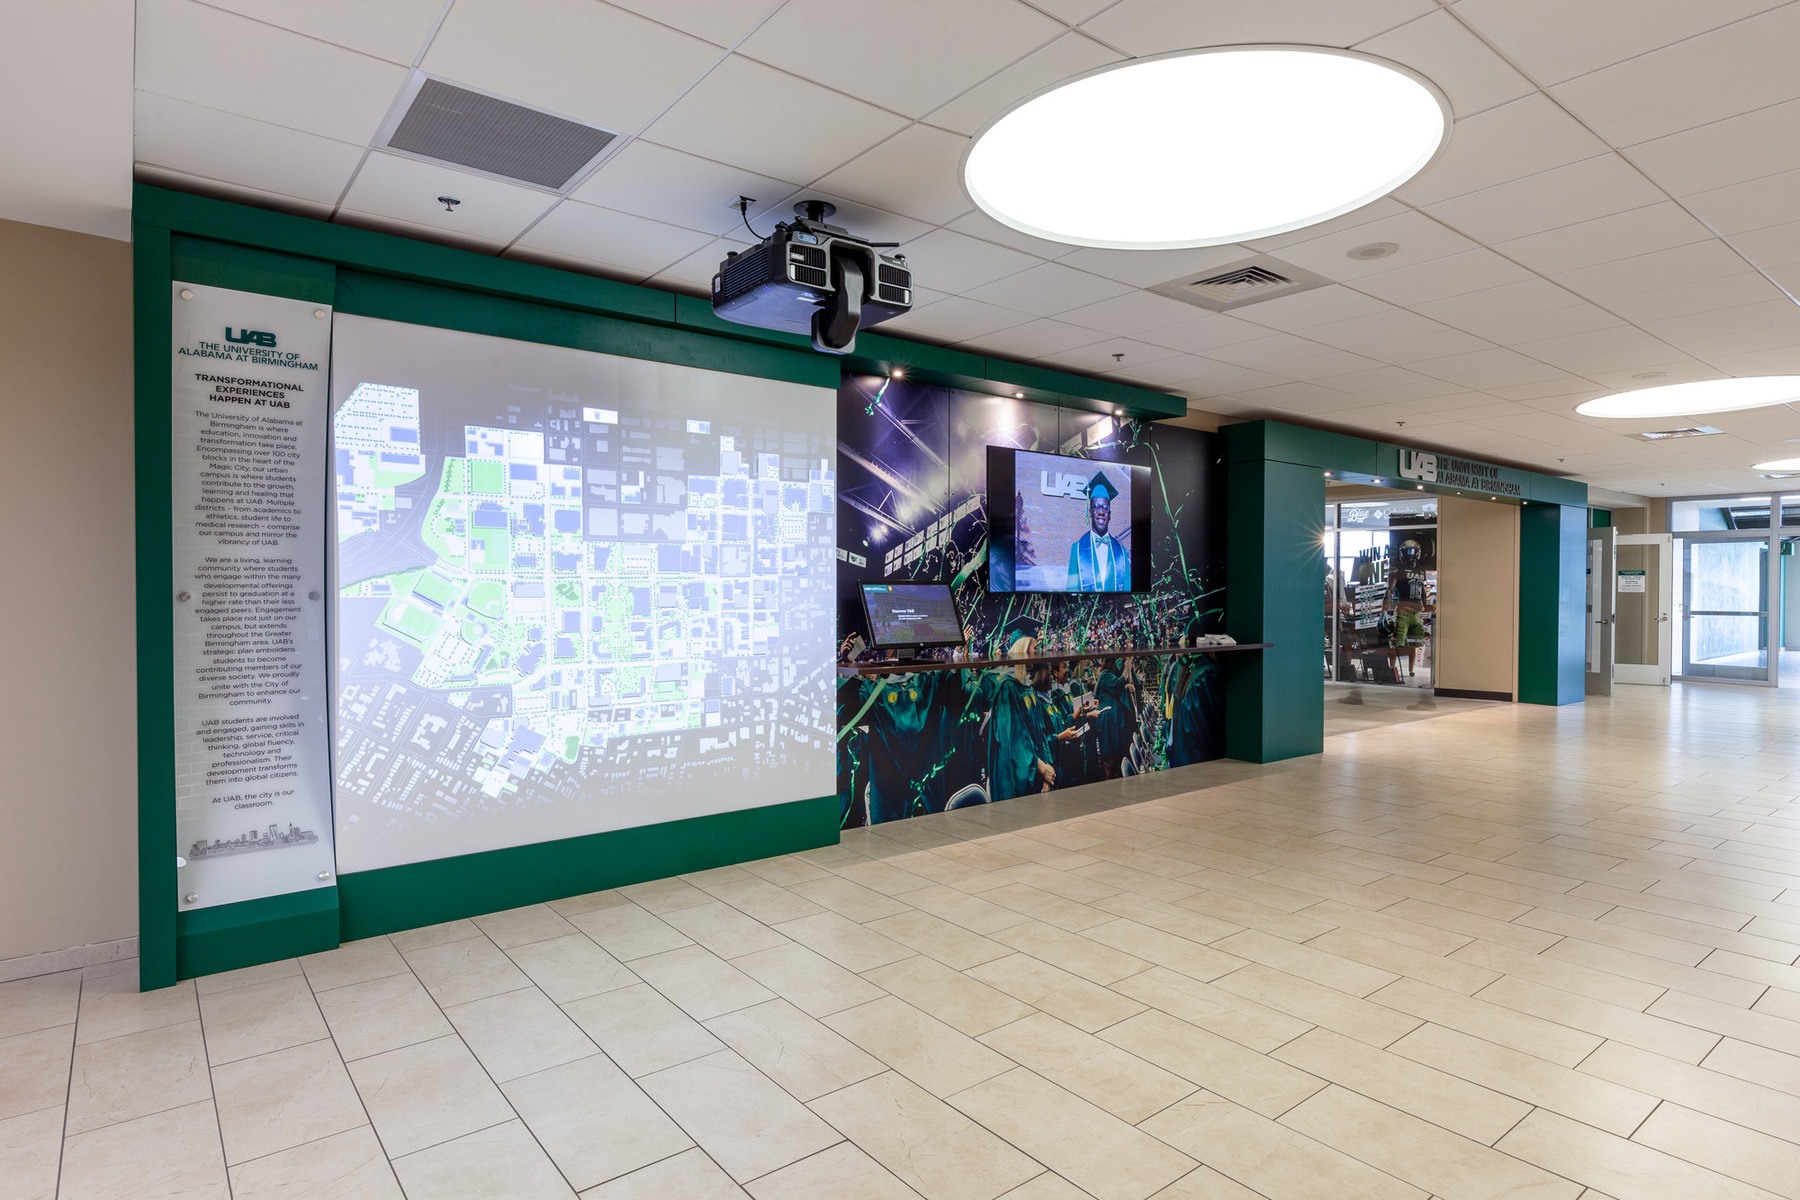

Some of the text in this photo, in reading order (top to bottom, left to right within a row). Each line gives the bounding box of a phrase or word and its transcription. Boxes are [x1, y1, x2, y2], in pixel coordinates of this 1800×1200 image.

[225, 327, 277, 348] UAB
[199, 341, 300, 360] THE UNIVERSITY OF
[178, 347, 318, 370] ALABAMA AT BIRMINGHAM
[195, 373, 304, 391] TRANSFORMATIONAL
[215, 385, 285, 398] EXPERIENCES
[209, 394, 251, 405] HAPPEN
[269, 400, 290, 408] UAB
[211, 412, 250, 423] University
[261, 416, 294, 425] Alabama
[210, 420, 257, 431] Birmingham
[265, 425, 289, 433] where
[242, 431, 281, 440] innovation
[200, 437, 257, 447] transformation
[196, 445, 252, 456] Encompassing
[286, 451, 301, 459] city
[209, 463, 232, 472] Magic
[1398, 449, 1437, 482] UAB
[1451, 460, 1489, 477] UNIVERSITY
[200, 472, 231, 480] campus
[265, 474, 296, 482] students
[201, 479, 242, 487] contribute
[1041, 471, 1091, 500] UAB
[1481, 479, 1520, 496] BIRMINGHAM
[202, 488, 234, 497] learning
[251, 490, 278, 499] healing
[201, 496, 235, 505] happens
[266, 499, 295, 507] Multiple
[217, 538, 250, 546] vibrancy
[203, 582, 293, 590] developmental offerings
[201, 599, 227, 607] higher
[194, 607, 230, 615] engaged
[255, 606, 301, 614] Engagement
[206, 631, 249, 640] throughout
[204, 639, 251, 648] Birmingham
[202, 648, 236, 657] strategic
[237, 647, 254, 655] plan
[195, 665, 243, 675] contributing
[272, 670, 300, 679] proudly
[198, 691, 245, 701] Birmingham
[256, 688, 287, 696] enhance
[221, 717, 254, 725] students
[269, 713, 299, 721] involved
[275, 729, 299, 737] critical
[242, 740, 266, 749] global
[223, 748, 266, 760] technology
[206, 762, 297, 778] development transforms
[205, 777, 226, 785] them
[227, 775, 243, 783] into
[244, 773, 268, 782] global
[258, 791, 273, 800] city
